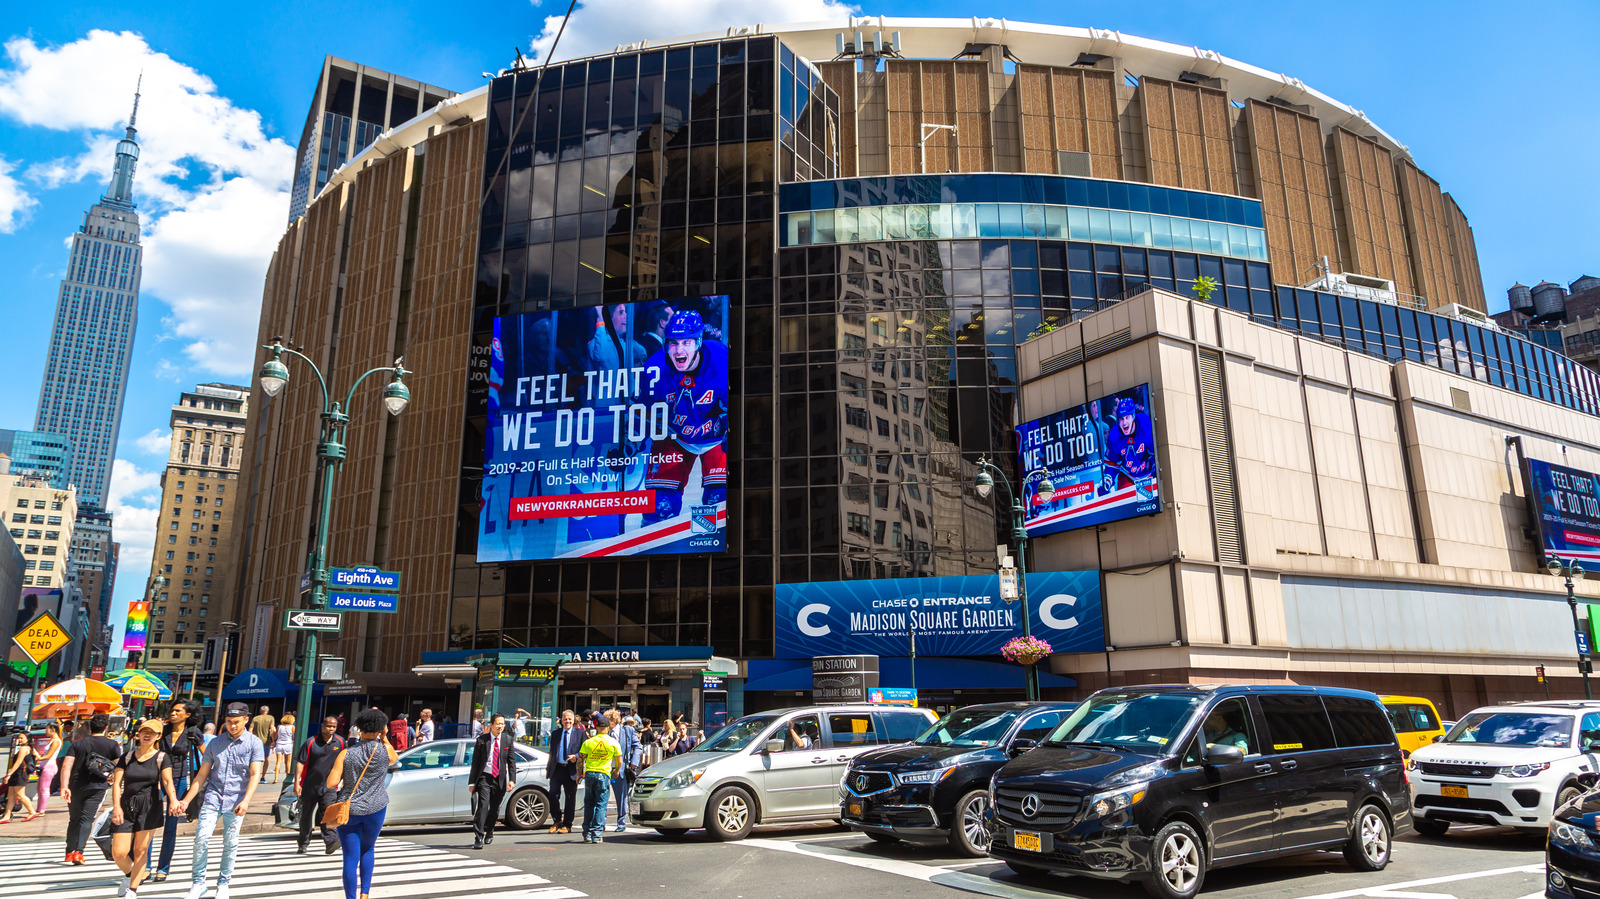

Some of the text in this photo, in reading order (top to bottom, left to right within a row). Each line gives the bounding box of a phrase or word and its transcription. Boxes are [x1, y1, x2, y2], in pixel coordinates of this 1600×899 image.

[516, 366, 660, 406] FEEL THAT?
[503, 402, 676, 451] WE DO TOO.
[1028, 413, 1089, 447] FEEL THAT?
[1024, 432, 1098, 471] WE DO TOO.
[489, 453, 684, 475] 2019-20 Full & Half Season Tickets
[1085, 459, 1102, 468] Tickets
[547, 472, 619, 486] On Sale Now
[1551, 470, 1593, 494] FEEL THAT?
[516, 496, 648, 512] NEWYORKRANGERS.COM
[1551, 489, 1567, 512] WE
[1567, 492, 1581, 514] DO
[337, 572, 394, 585] Eighth Ave
[335, 597, 350, 606] Joe
[353, 597, 376, 607] Louis
[872, 596, 991, 608] CHASE ENTRANCE
[1038, 594, 1079, 630] C
[796, 603, 831, 637] C
[850, 612, 906, 631] MADISON
[910, 610, 958, 630] SQUARE
[28, 629, 58, 637] DEAD
[30, 641, 52, 649] END
[586, 651, 639, 661] STATION
[826, 659, 856, 669] STATION
[249, 674, 258, 687] D
[822, 688, 840, 697] SQUARE
[841, 687, 860, 696] GARDEN
